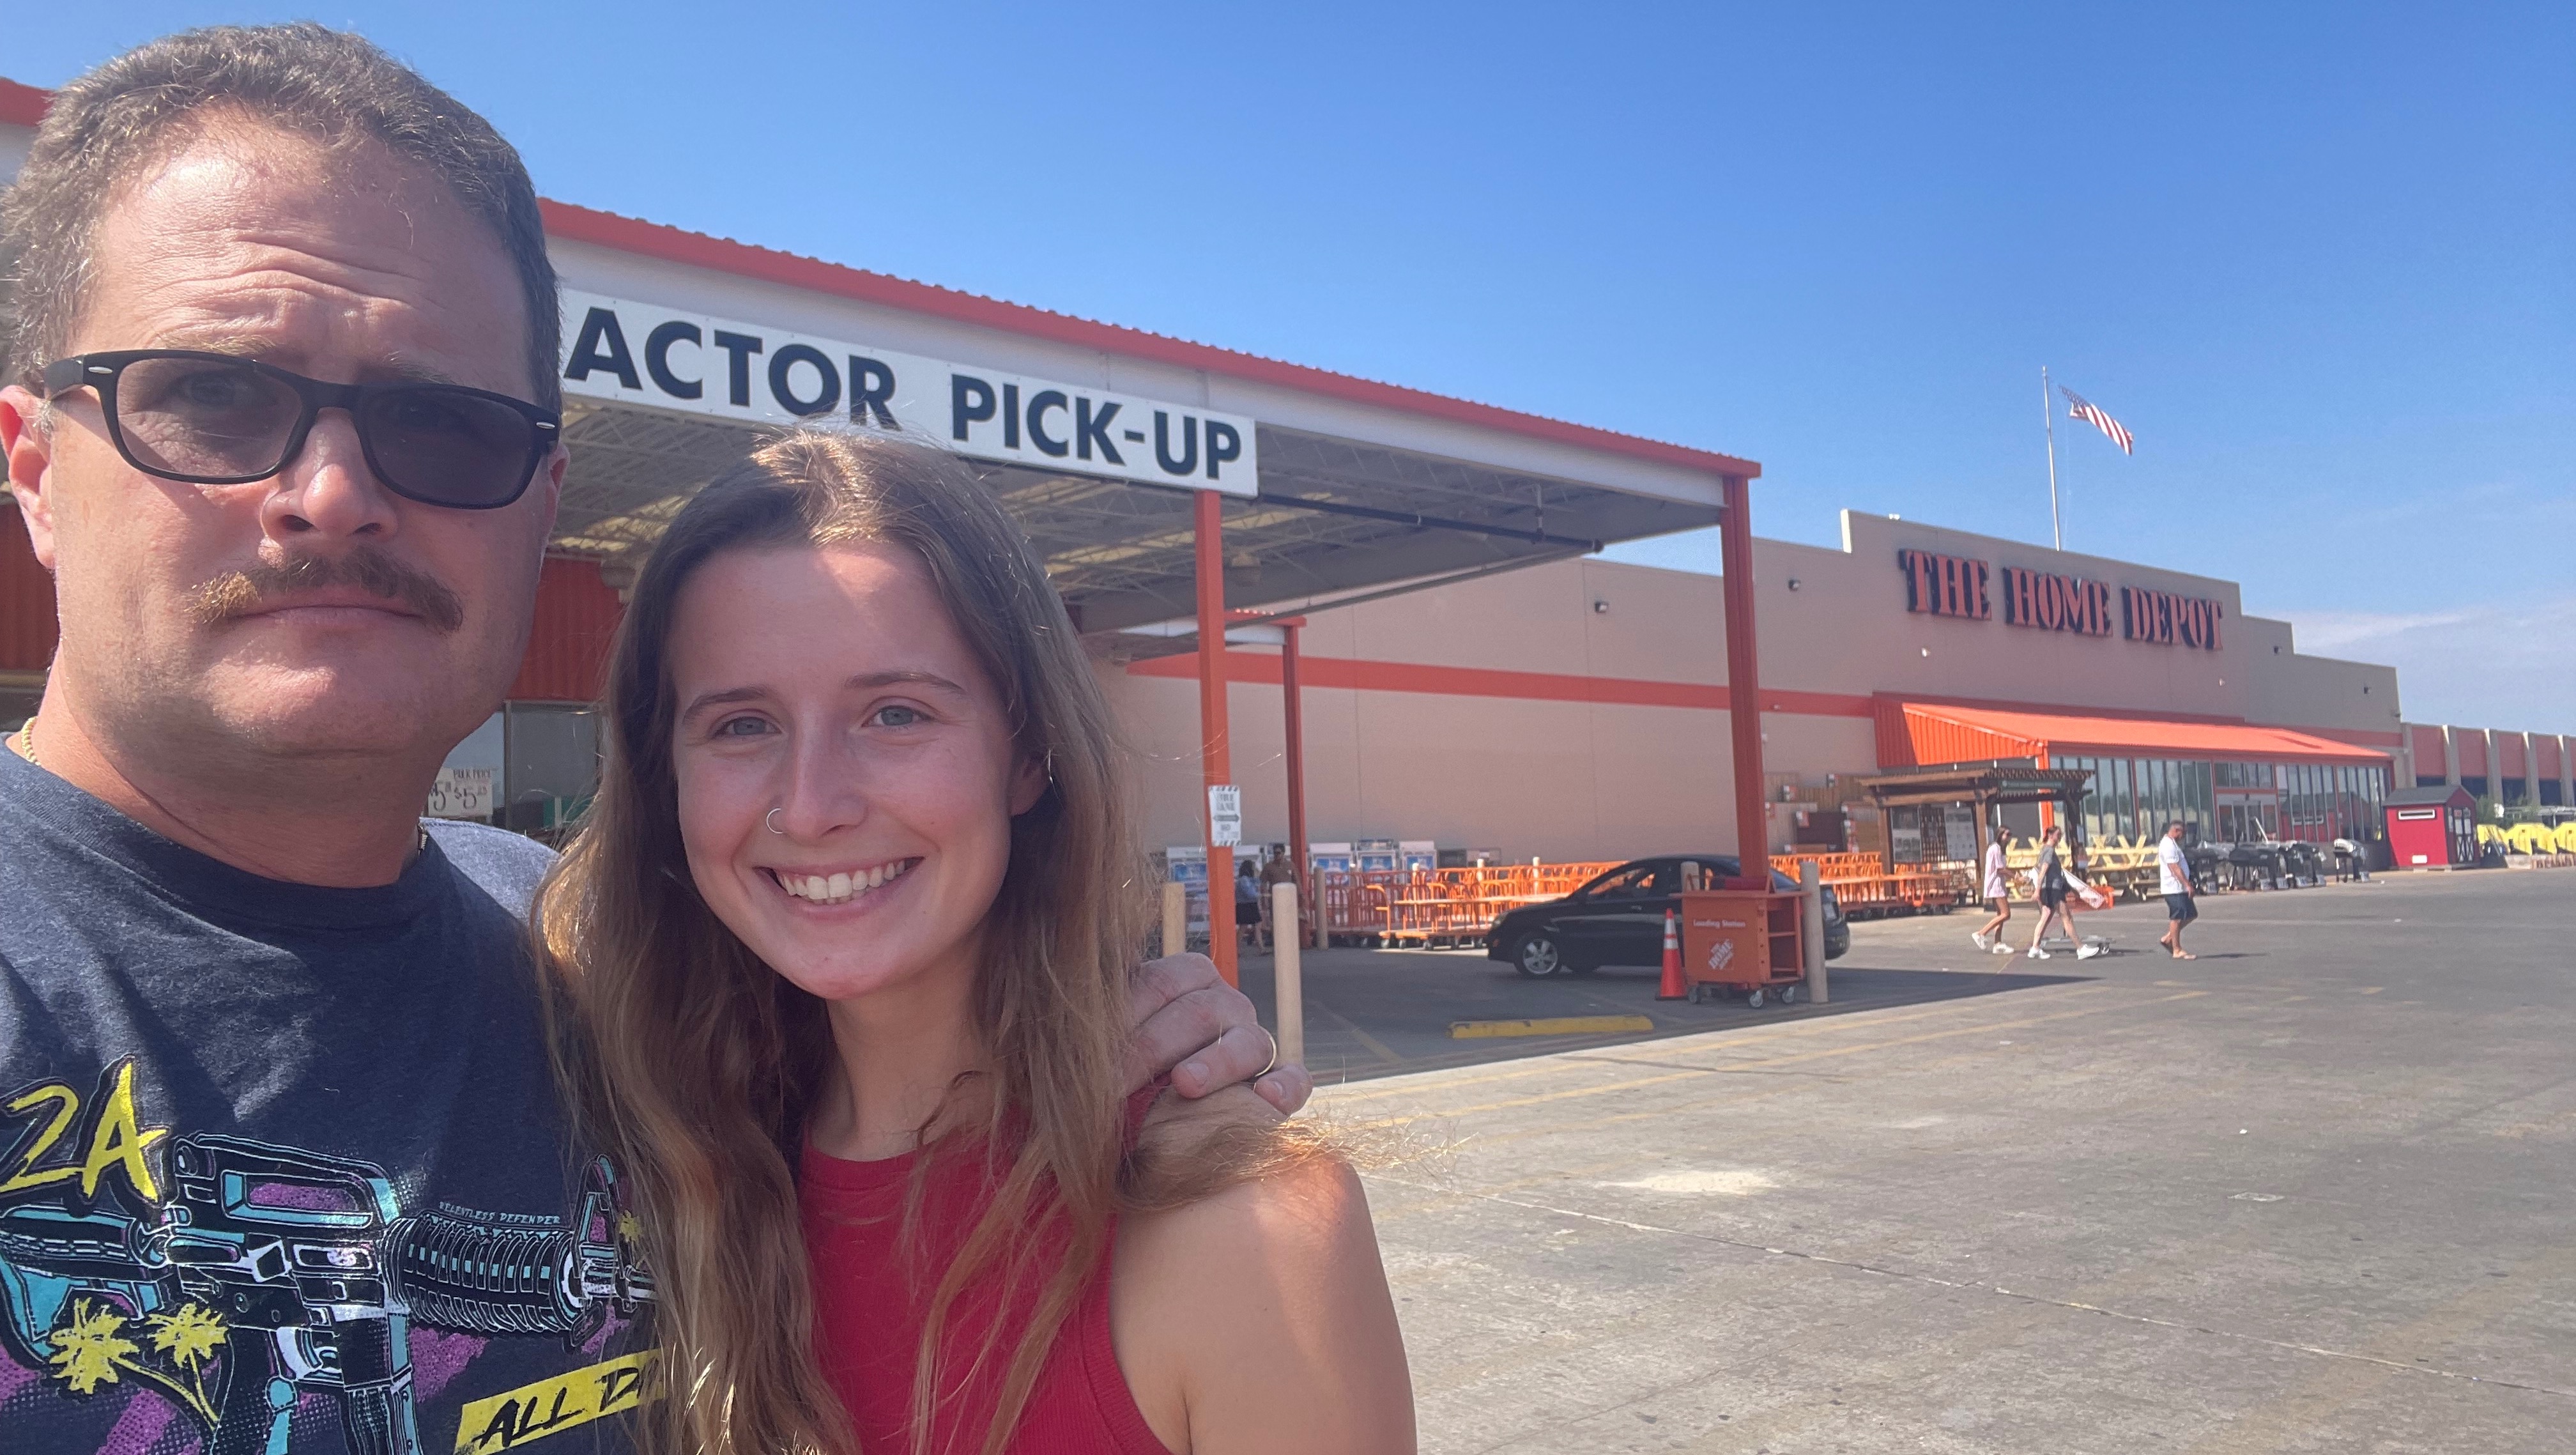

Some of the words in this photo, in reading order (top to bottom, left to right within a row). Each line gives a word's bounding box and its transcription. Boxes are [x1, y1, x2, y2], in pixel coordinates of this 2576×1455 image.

[564, 306, 901, 431] ACTOR
[951, 373, 1242, 480] PICK-UP
[1899, 548, 1993, 621] THE
[2002, 566, 2113, 638] HOME
[2121, 585, 2224, 651] DEPOT
[1693, 919, 1720, 929] Loading
[0, 1062, 167, 1203] 2A
[440, 1201, 496, 1221] RELENTLESS
[500, 1213, 561, 1225] DEFENDER
[471, 1387, 587, 1450] ALL
